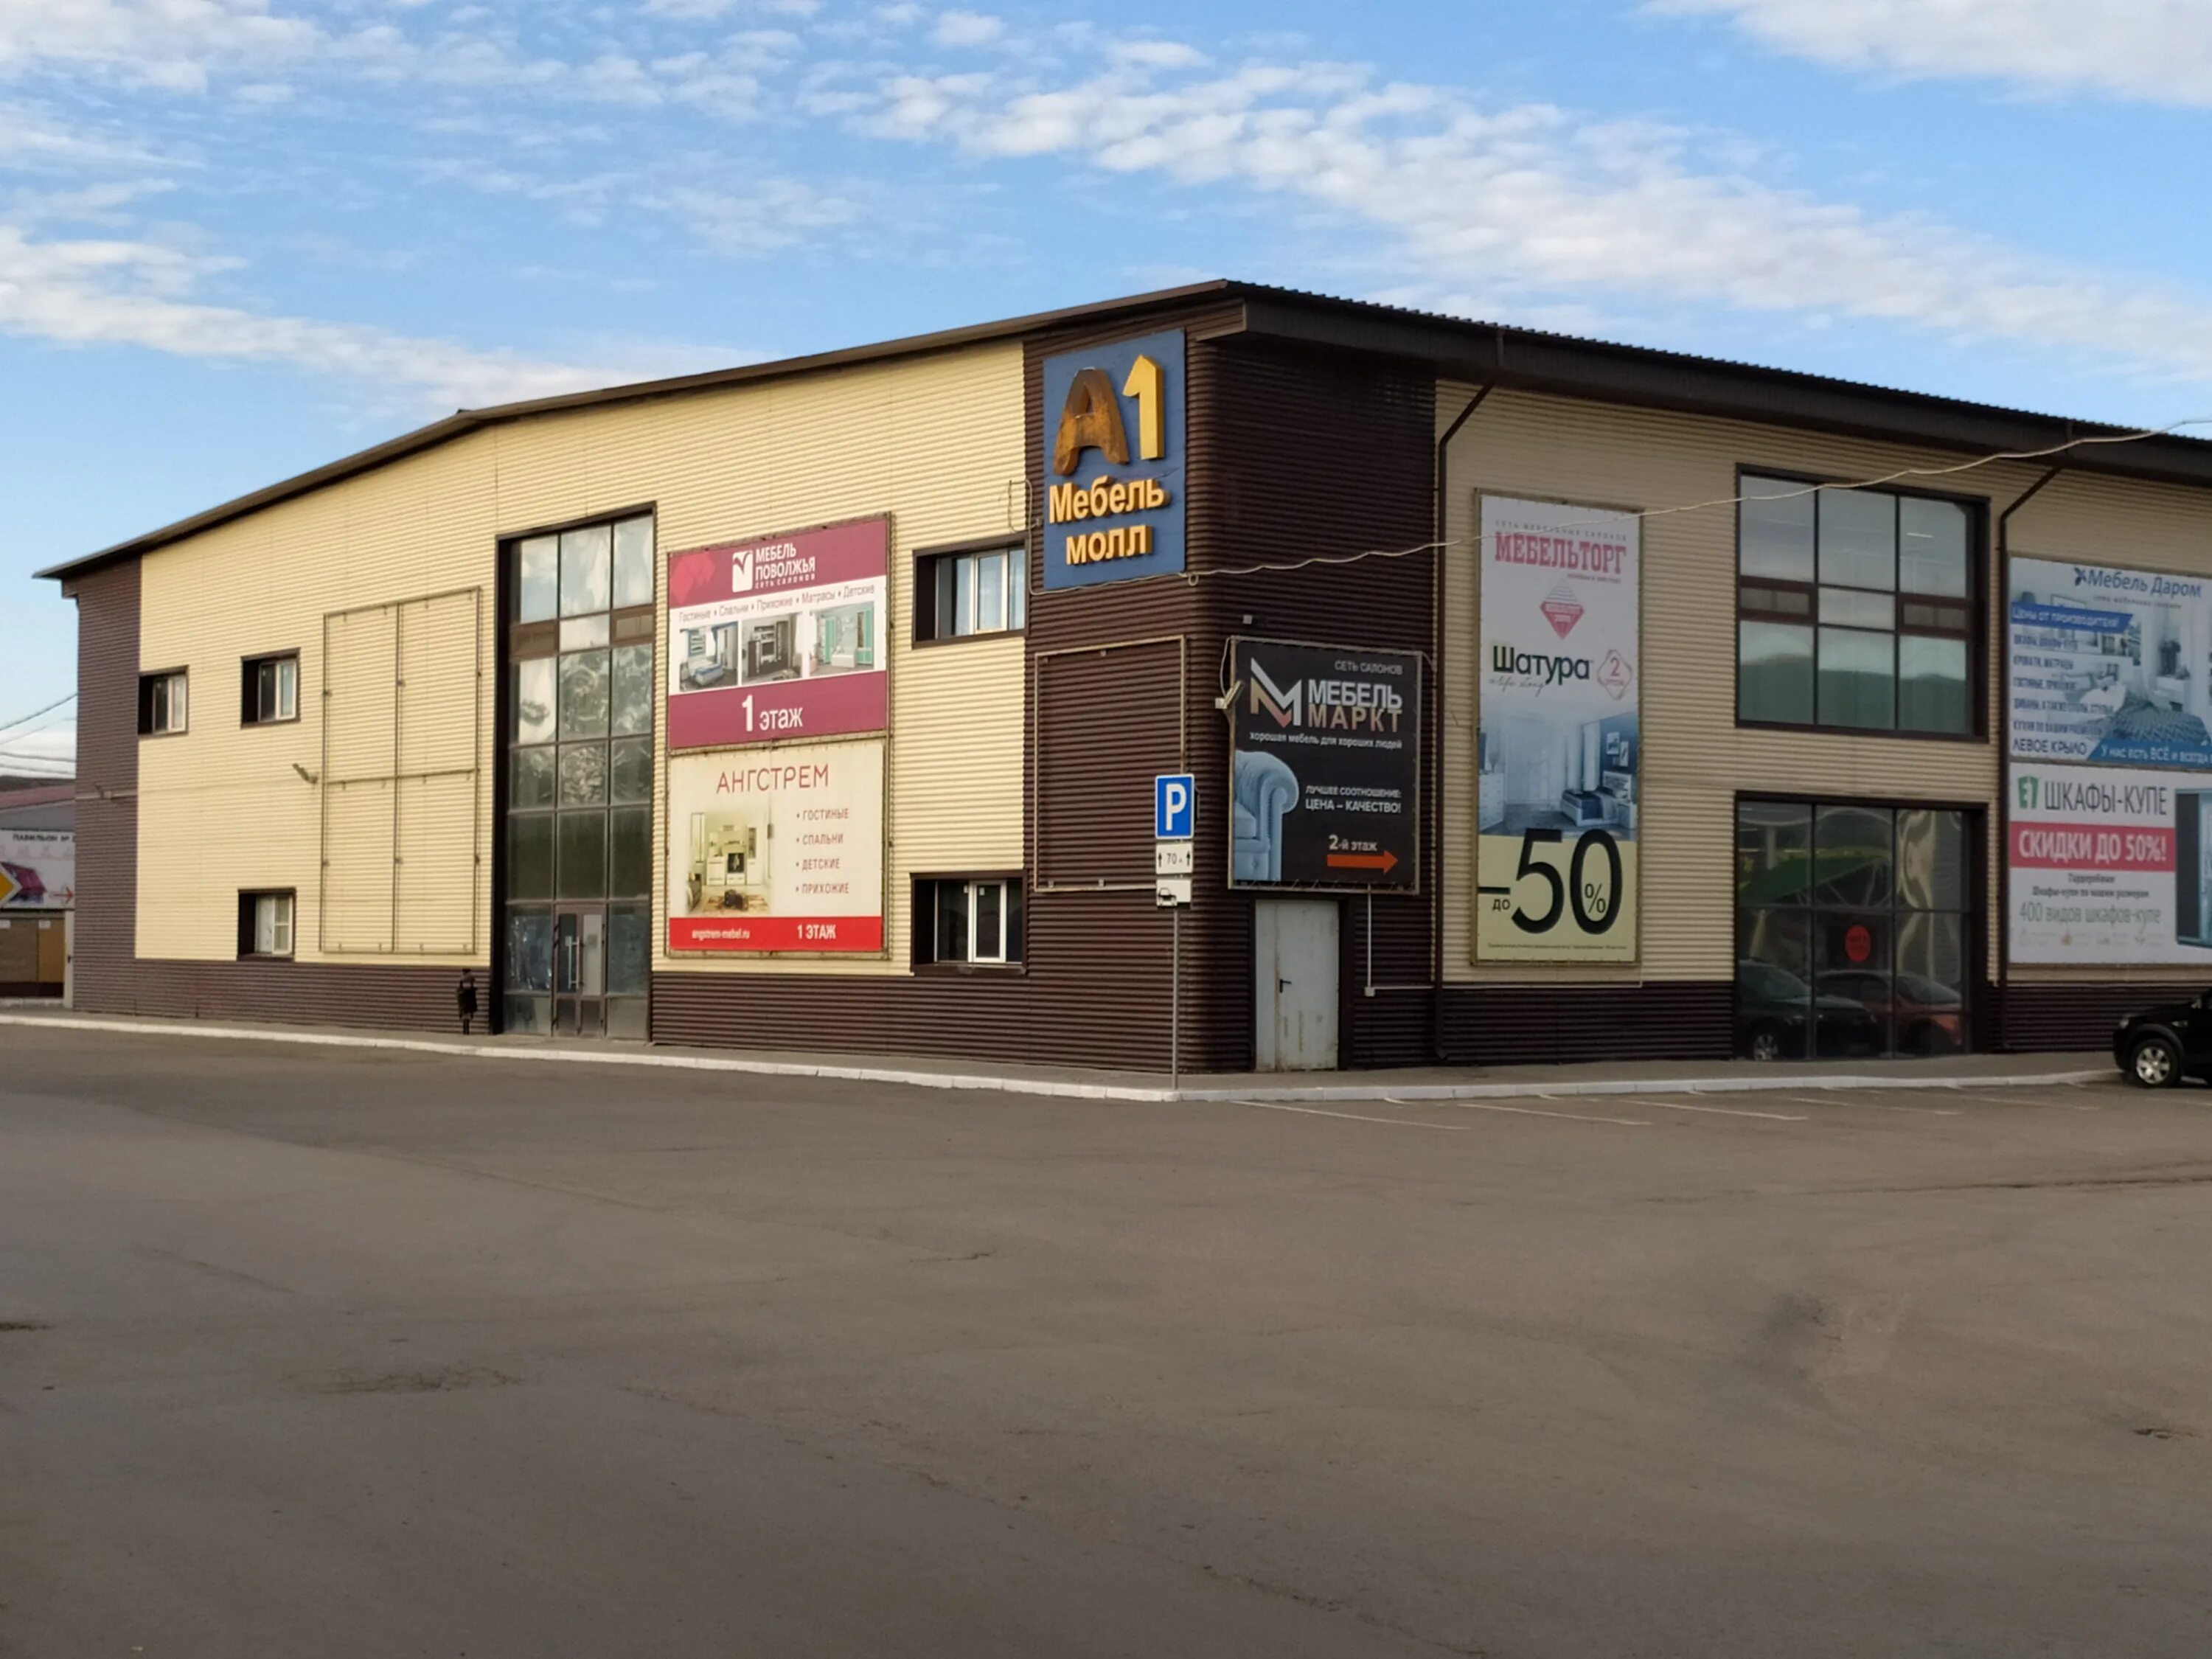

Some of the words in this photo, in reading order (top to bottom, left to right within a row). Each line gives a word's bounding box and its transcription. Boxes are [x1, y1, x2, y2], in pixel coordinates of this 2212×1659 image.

[1049, 475, 1169, 525] Мебель
[756, 543, 796, 563] МЕБЕЛЬ
[1066, 524, 1152, 566] молл
[1495, 531, 1627, 574] МЕБЕЛЬТОРГ
[755, 557, 815, 581] ПОВОЛЖЬЯ
[2088, 569, 2148, 591] Мебель
[2151, 577, 2202, 599] Даром
[1335, 660, 1357, 672] СЕТЬ
[1360, 663, 1402, 675] САЛОНОВ
[1493, 645, 1590, 686] Шатура
[1610, 656, 1620, 677] 2
[1308, 678, 1403, 710] МЕБЕЛЬ
[742, 695, 753, 731] 1
[759, 707, 803, 731] этаж
[1308, 705, 1403, 734] МАРКТ
[2013, 738, 2048, 753] ЛЕВОЕ
[2051, 741, 2087, 755] КРЫЛО
[717, 764, 829, 794] АНГСТРЕМ
[1166, 783, 1187, 831] P
[1306, 799, 1335, 811] ЦЕНА
[1346, 800, 1401, 813] КАЧЕСТВО!
[2045, 781, 2167, 815] ШКАФЫ-КУПЕ
[802, 808, 849, 820] ГОСТИНЫЕ
[802, 834, 844, 845] СПАЛЬНИ
[1351, 840, 1377, 851] этаж
[2020, 830, 2091, 863] СКИДКИ
[2096, 833, 2121, 865] ДО
[2125, 835, 2167, 862] 50%!
[801, 858, 840, 871] ДЕТСКИЕ
[1166, 852, 1178, 865] 70
[801, 883, 849, 894] ПРИХОЖИЕ
[797, 925, 803, 939] 1
[806, 925, 836, 940] ЭТАЖ
